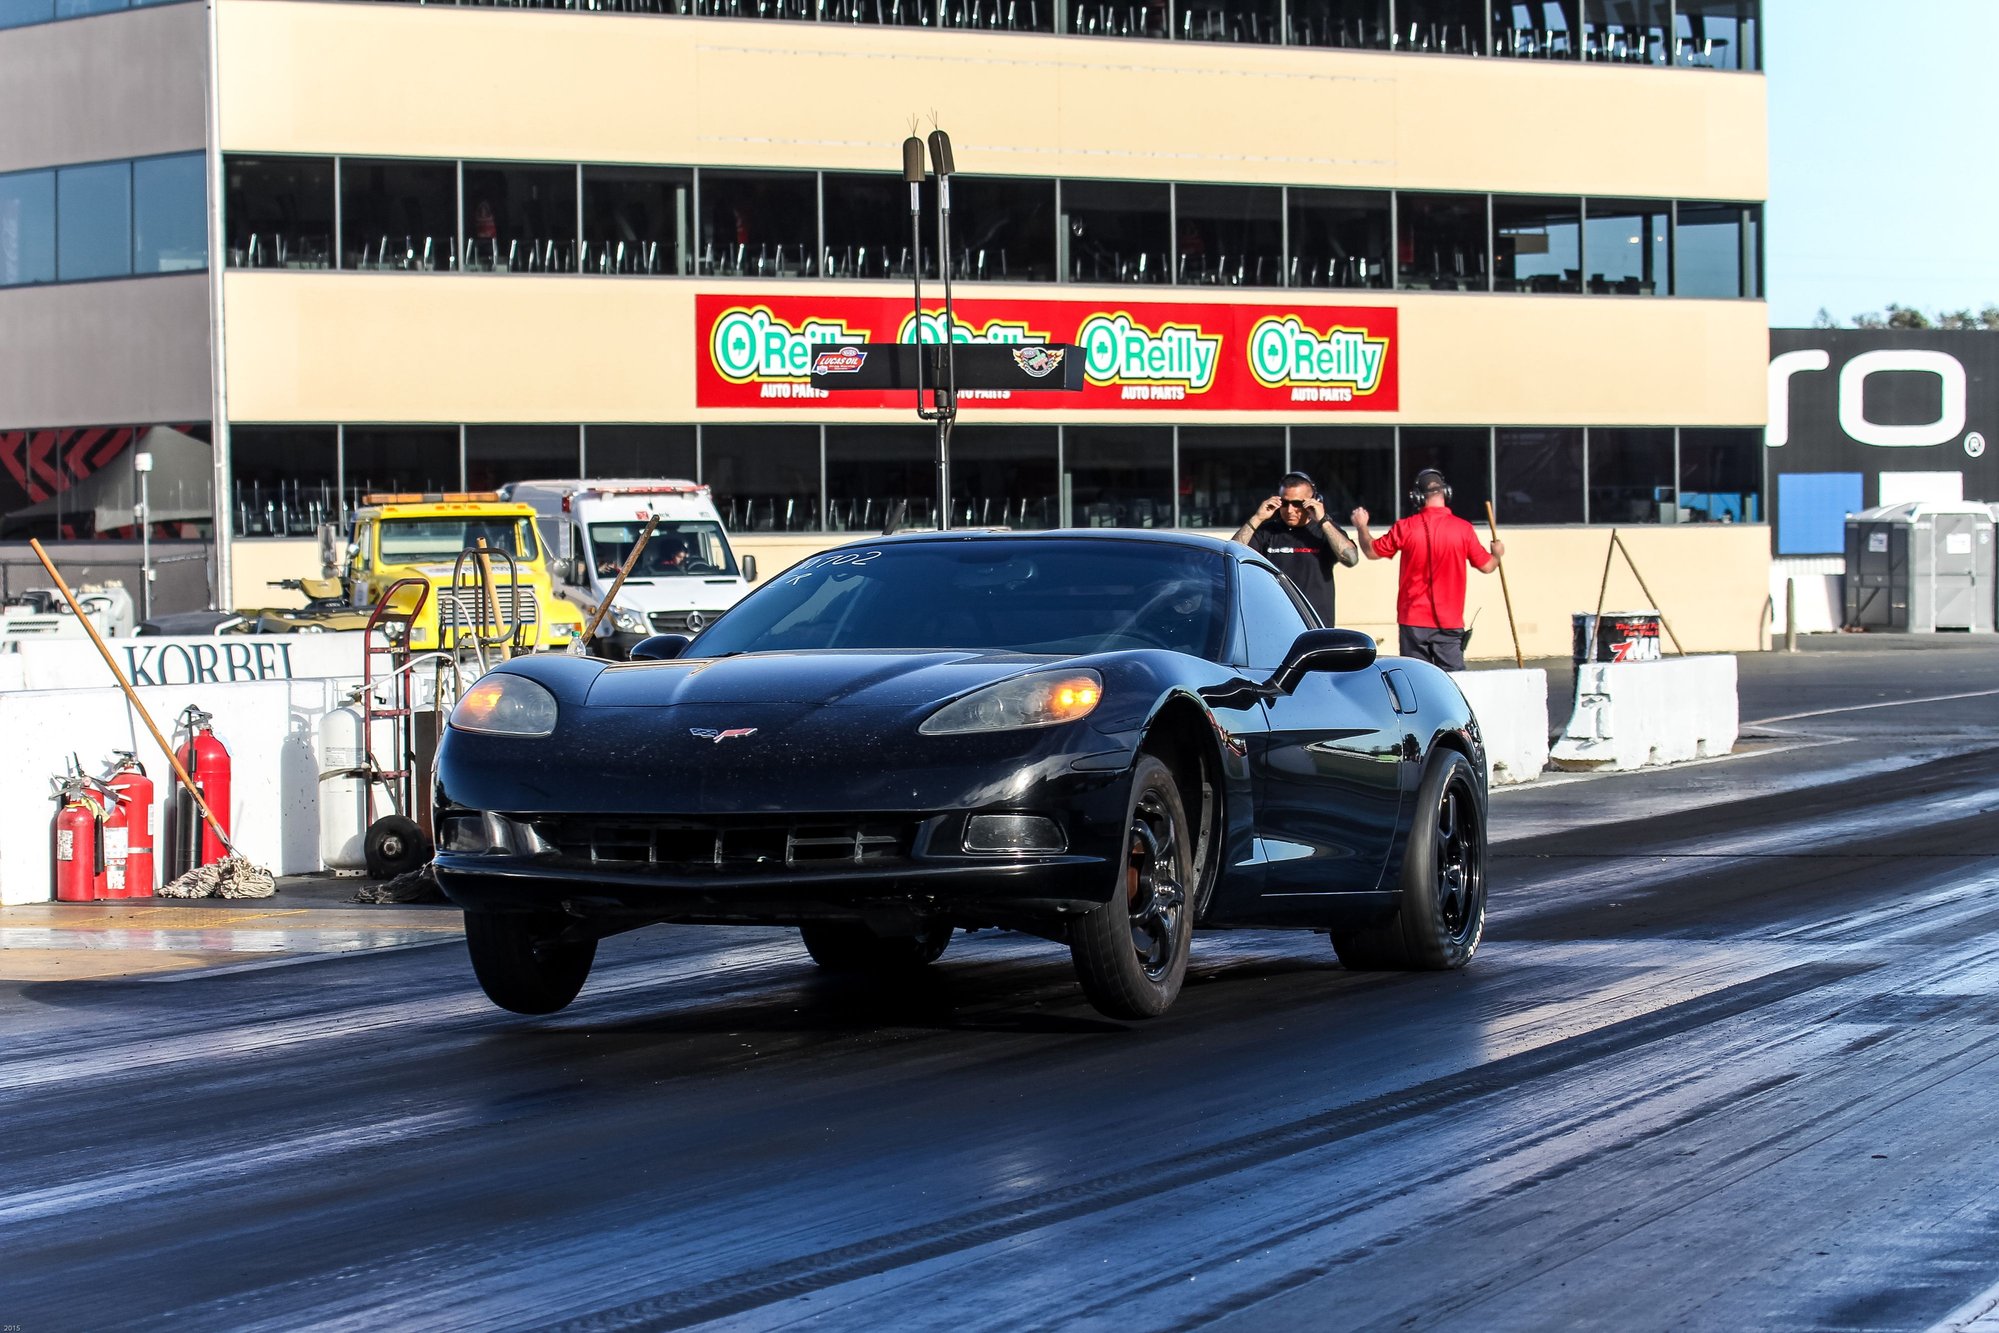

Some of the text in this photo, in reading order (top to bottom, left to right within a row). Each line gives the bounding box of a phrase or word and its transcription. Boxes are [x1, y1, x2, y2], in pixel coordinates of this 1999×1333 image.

[1087, 325, 1210, 380] O'Reilly
[1258, 328, 1376, 382] O'Reilly
[820, 357, 858, 365] LUCAS OIL
[761, 383, 790, 398] AUTO
[1121, 385, 1185, 400] AUTO PARTS
[1291, 387, 1352, 401] AUTO PARTS
